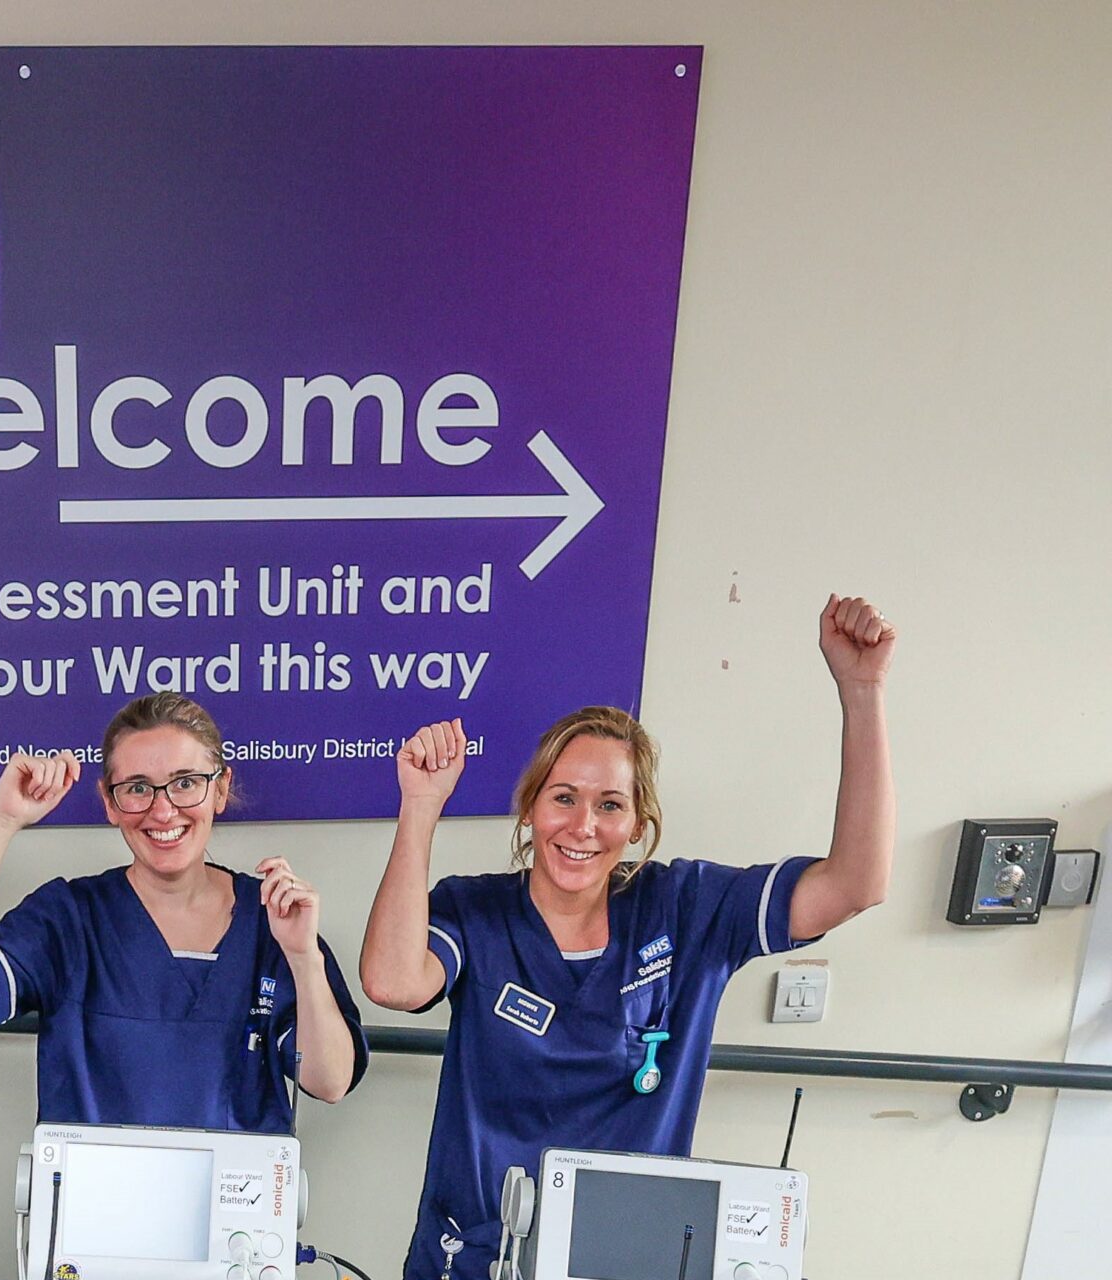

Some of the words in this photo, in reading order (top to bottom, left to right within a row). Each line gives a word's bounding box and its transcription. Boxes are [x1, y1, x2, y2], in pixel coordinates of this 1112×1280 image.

[258, 565, 365, 617] Unit
[381, 563, 492, 615] and
[92, 643, 241, 694] Ward
[258, 641, 353, 691] this
[370, 648, 490, 700] way
[222, 740, 317, 763] Salisbury
[323, 737, 395, 760] District
[642, 939, 669, 960] NHS
[638, 955, 673, 976] Salisbur
[43, 1131, 82, 1139] HUNTLEIGH
[43, 1146, 55, 1163] 9
[554, 1157, 592, 1166] HUNTLEIGH
[219, 1183, 239, 1193] FSE
[552, 1172, 564, 1188] 8
[273, 1164, 284, 1217] sonicaid
[220, 1195, 251, 1206] Battery
[726, 1214, 747, 1223] FSE
[780, 1196, 792, 1247] sonicaid
[726, 1225, 757, 1238] Battery
